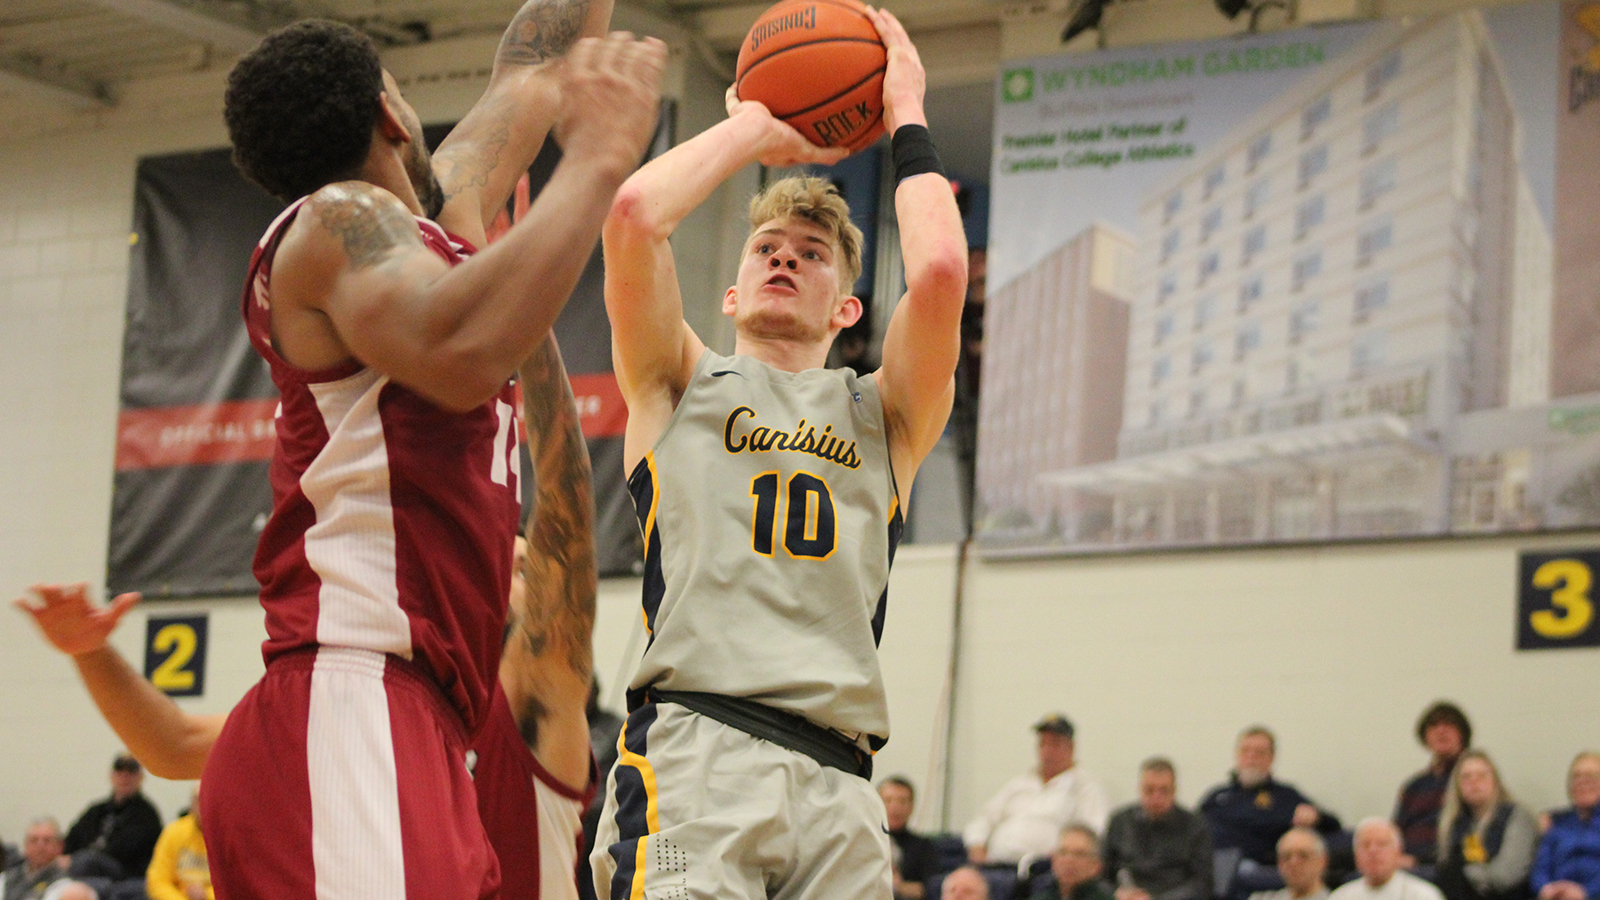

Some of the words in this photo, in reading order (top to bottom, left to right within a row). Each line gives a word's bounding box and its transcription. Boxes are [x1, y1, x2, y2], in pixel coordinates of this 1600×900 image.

[752, 6, 816, 51] CANISIUS
[1043, 56, 1195, 92] WYNDHAM
[1203, 42, 1326, 77] GARDEN
[812, 101, 873, 147] ROCK
[1062, 127, 1103, 143] Hotel
[1109, 122, 1163, 140] Partner
[1063, 150, 1121, 169] College
[1127, 142, 1195, 161] Athletics
[724, 405, 862, 470] Canisius
[749, 469, 839, 562] 10
[1529, 558, 1595, 639] 3
[151, 624, 197, 691] 2
